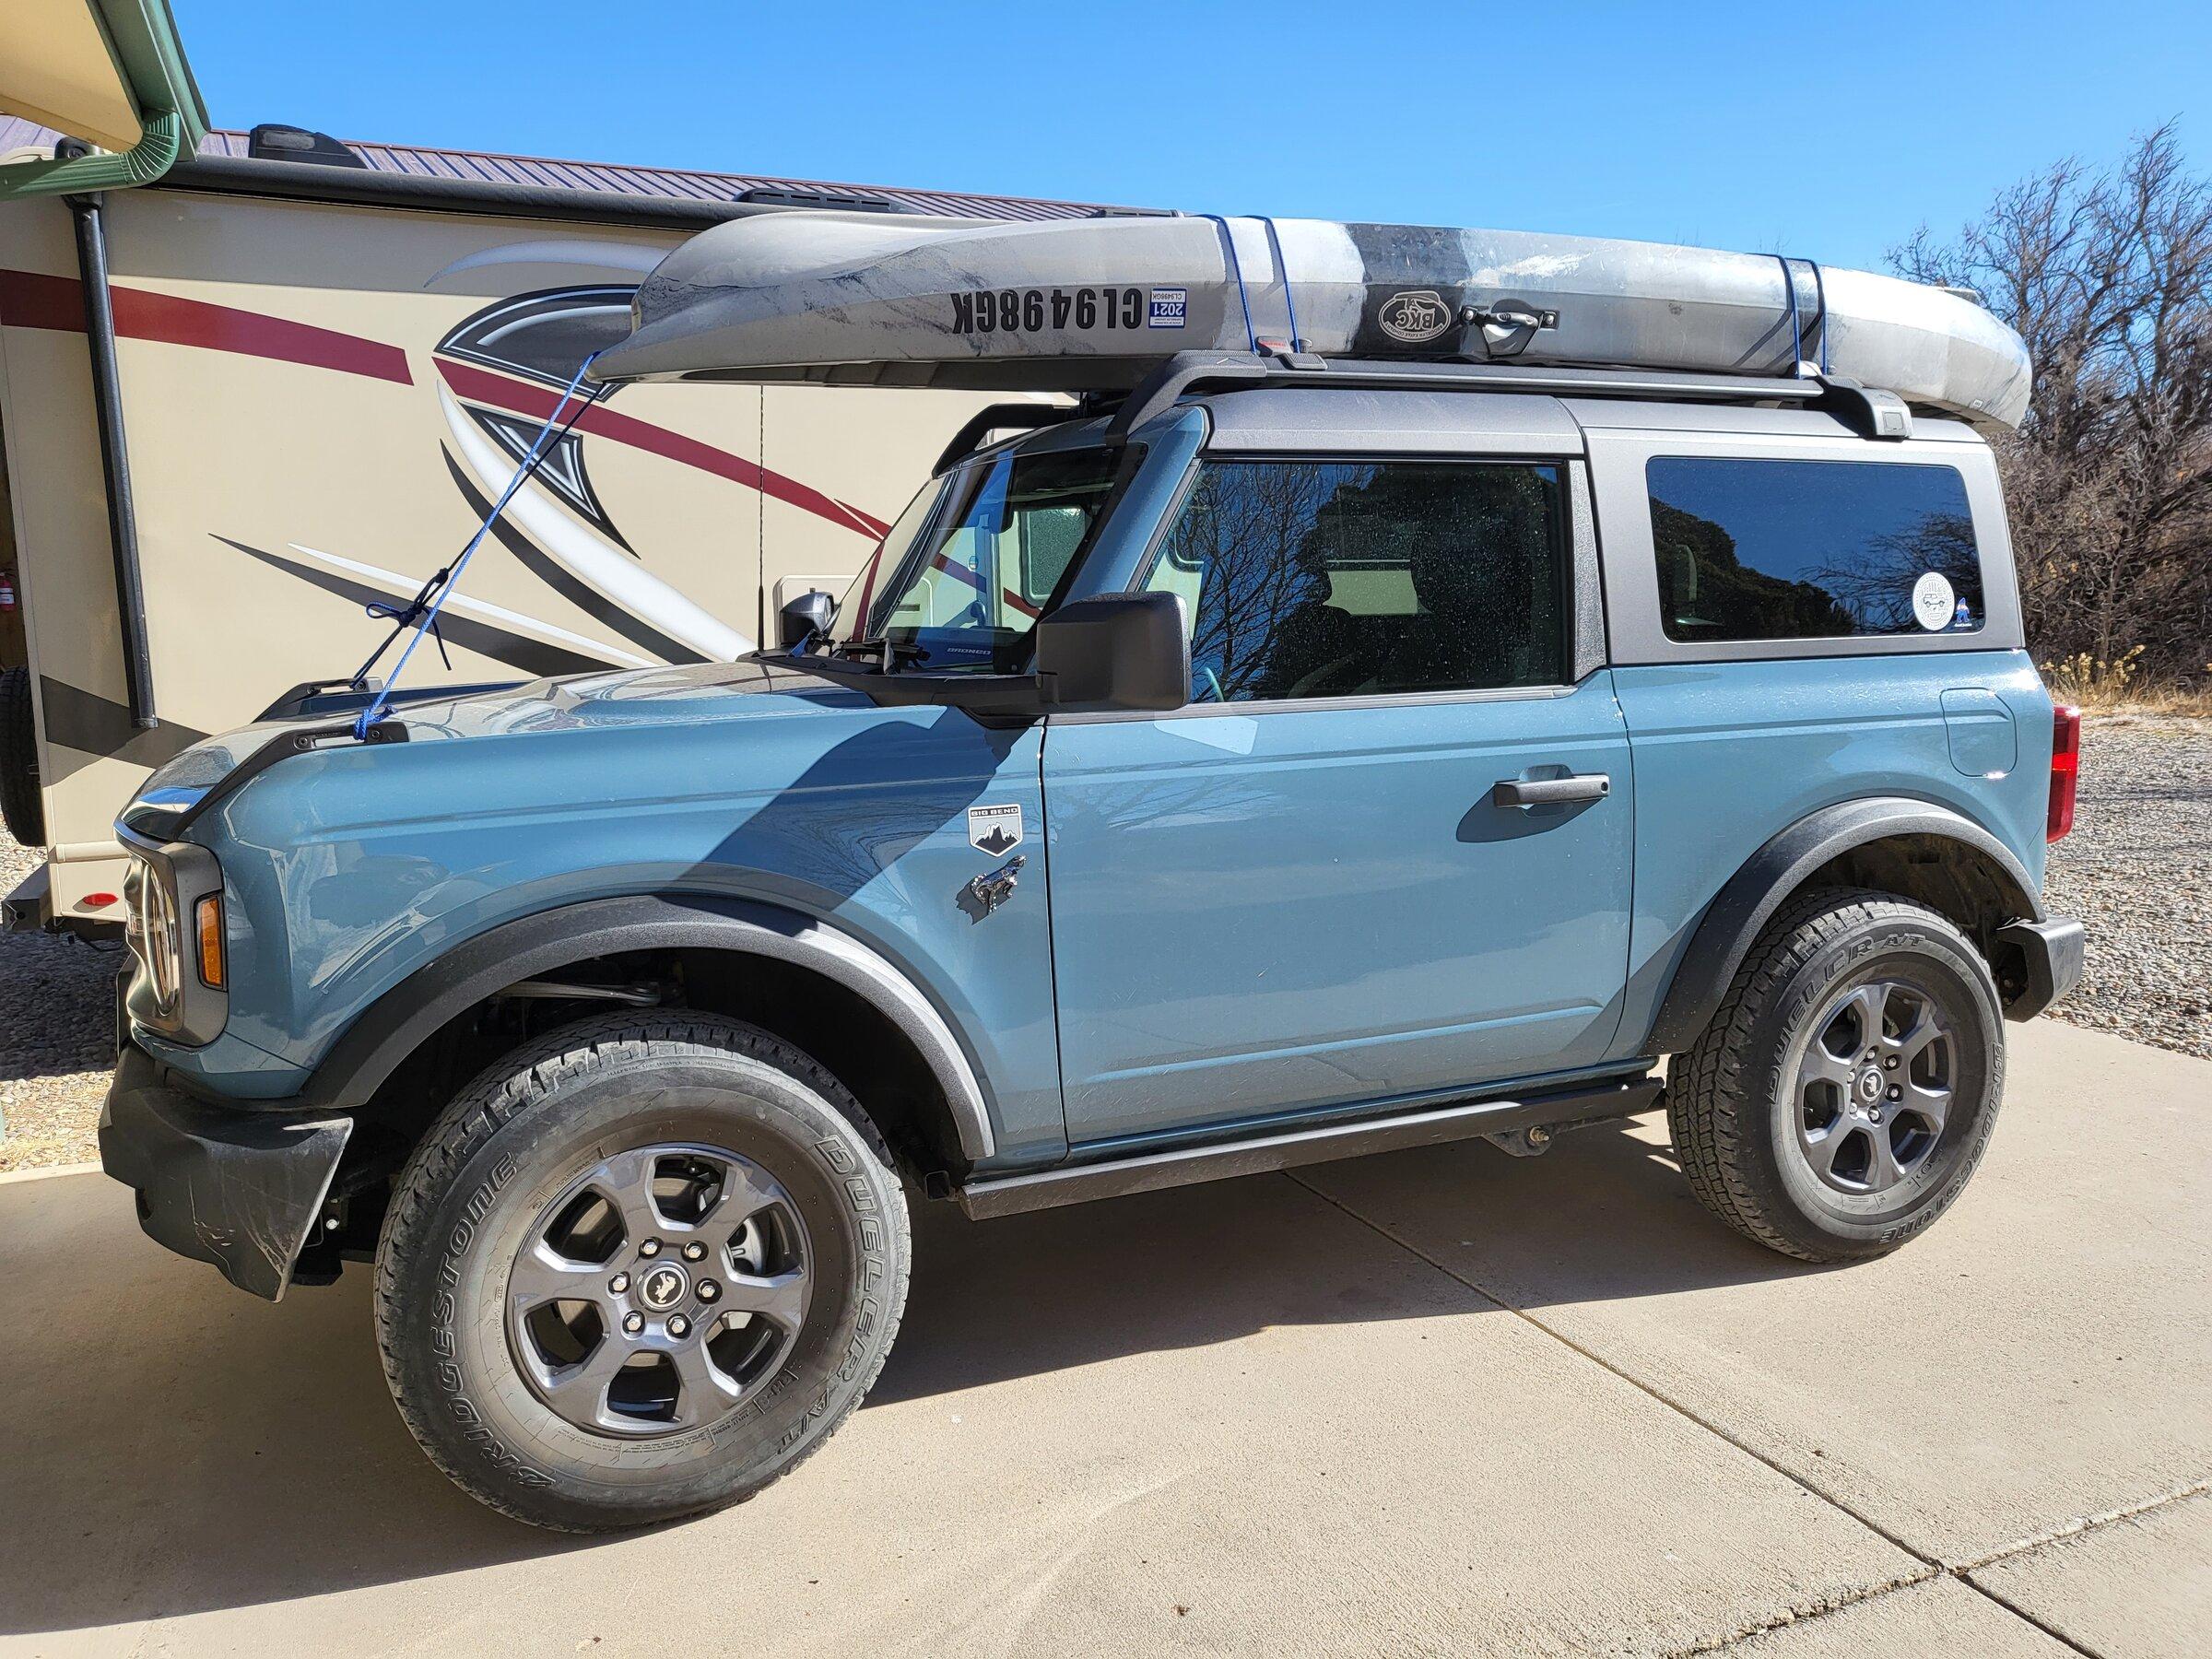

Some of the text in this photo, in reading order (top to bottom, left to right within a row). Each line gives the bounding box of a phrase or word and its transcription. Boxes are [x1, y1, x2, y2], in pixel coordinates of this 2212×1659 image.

[949, 288, 1143, 335] CL9498GK
[1154, 303, 1183, 316] 2021
[1395, 309, 1435, 330] BKC
[947, 647, 992, 655] BRONCO
[1764, 932, 1927, 1105] DUELER A/T
[1878, 1042, 2004, 1245] BRIDGESTONE
[815, 1133, 887, 1383] DUELER
[429, 1150, 556, 1488] BRIDGESTONE
